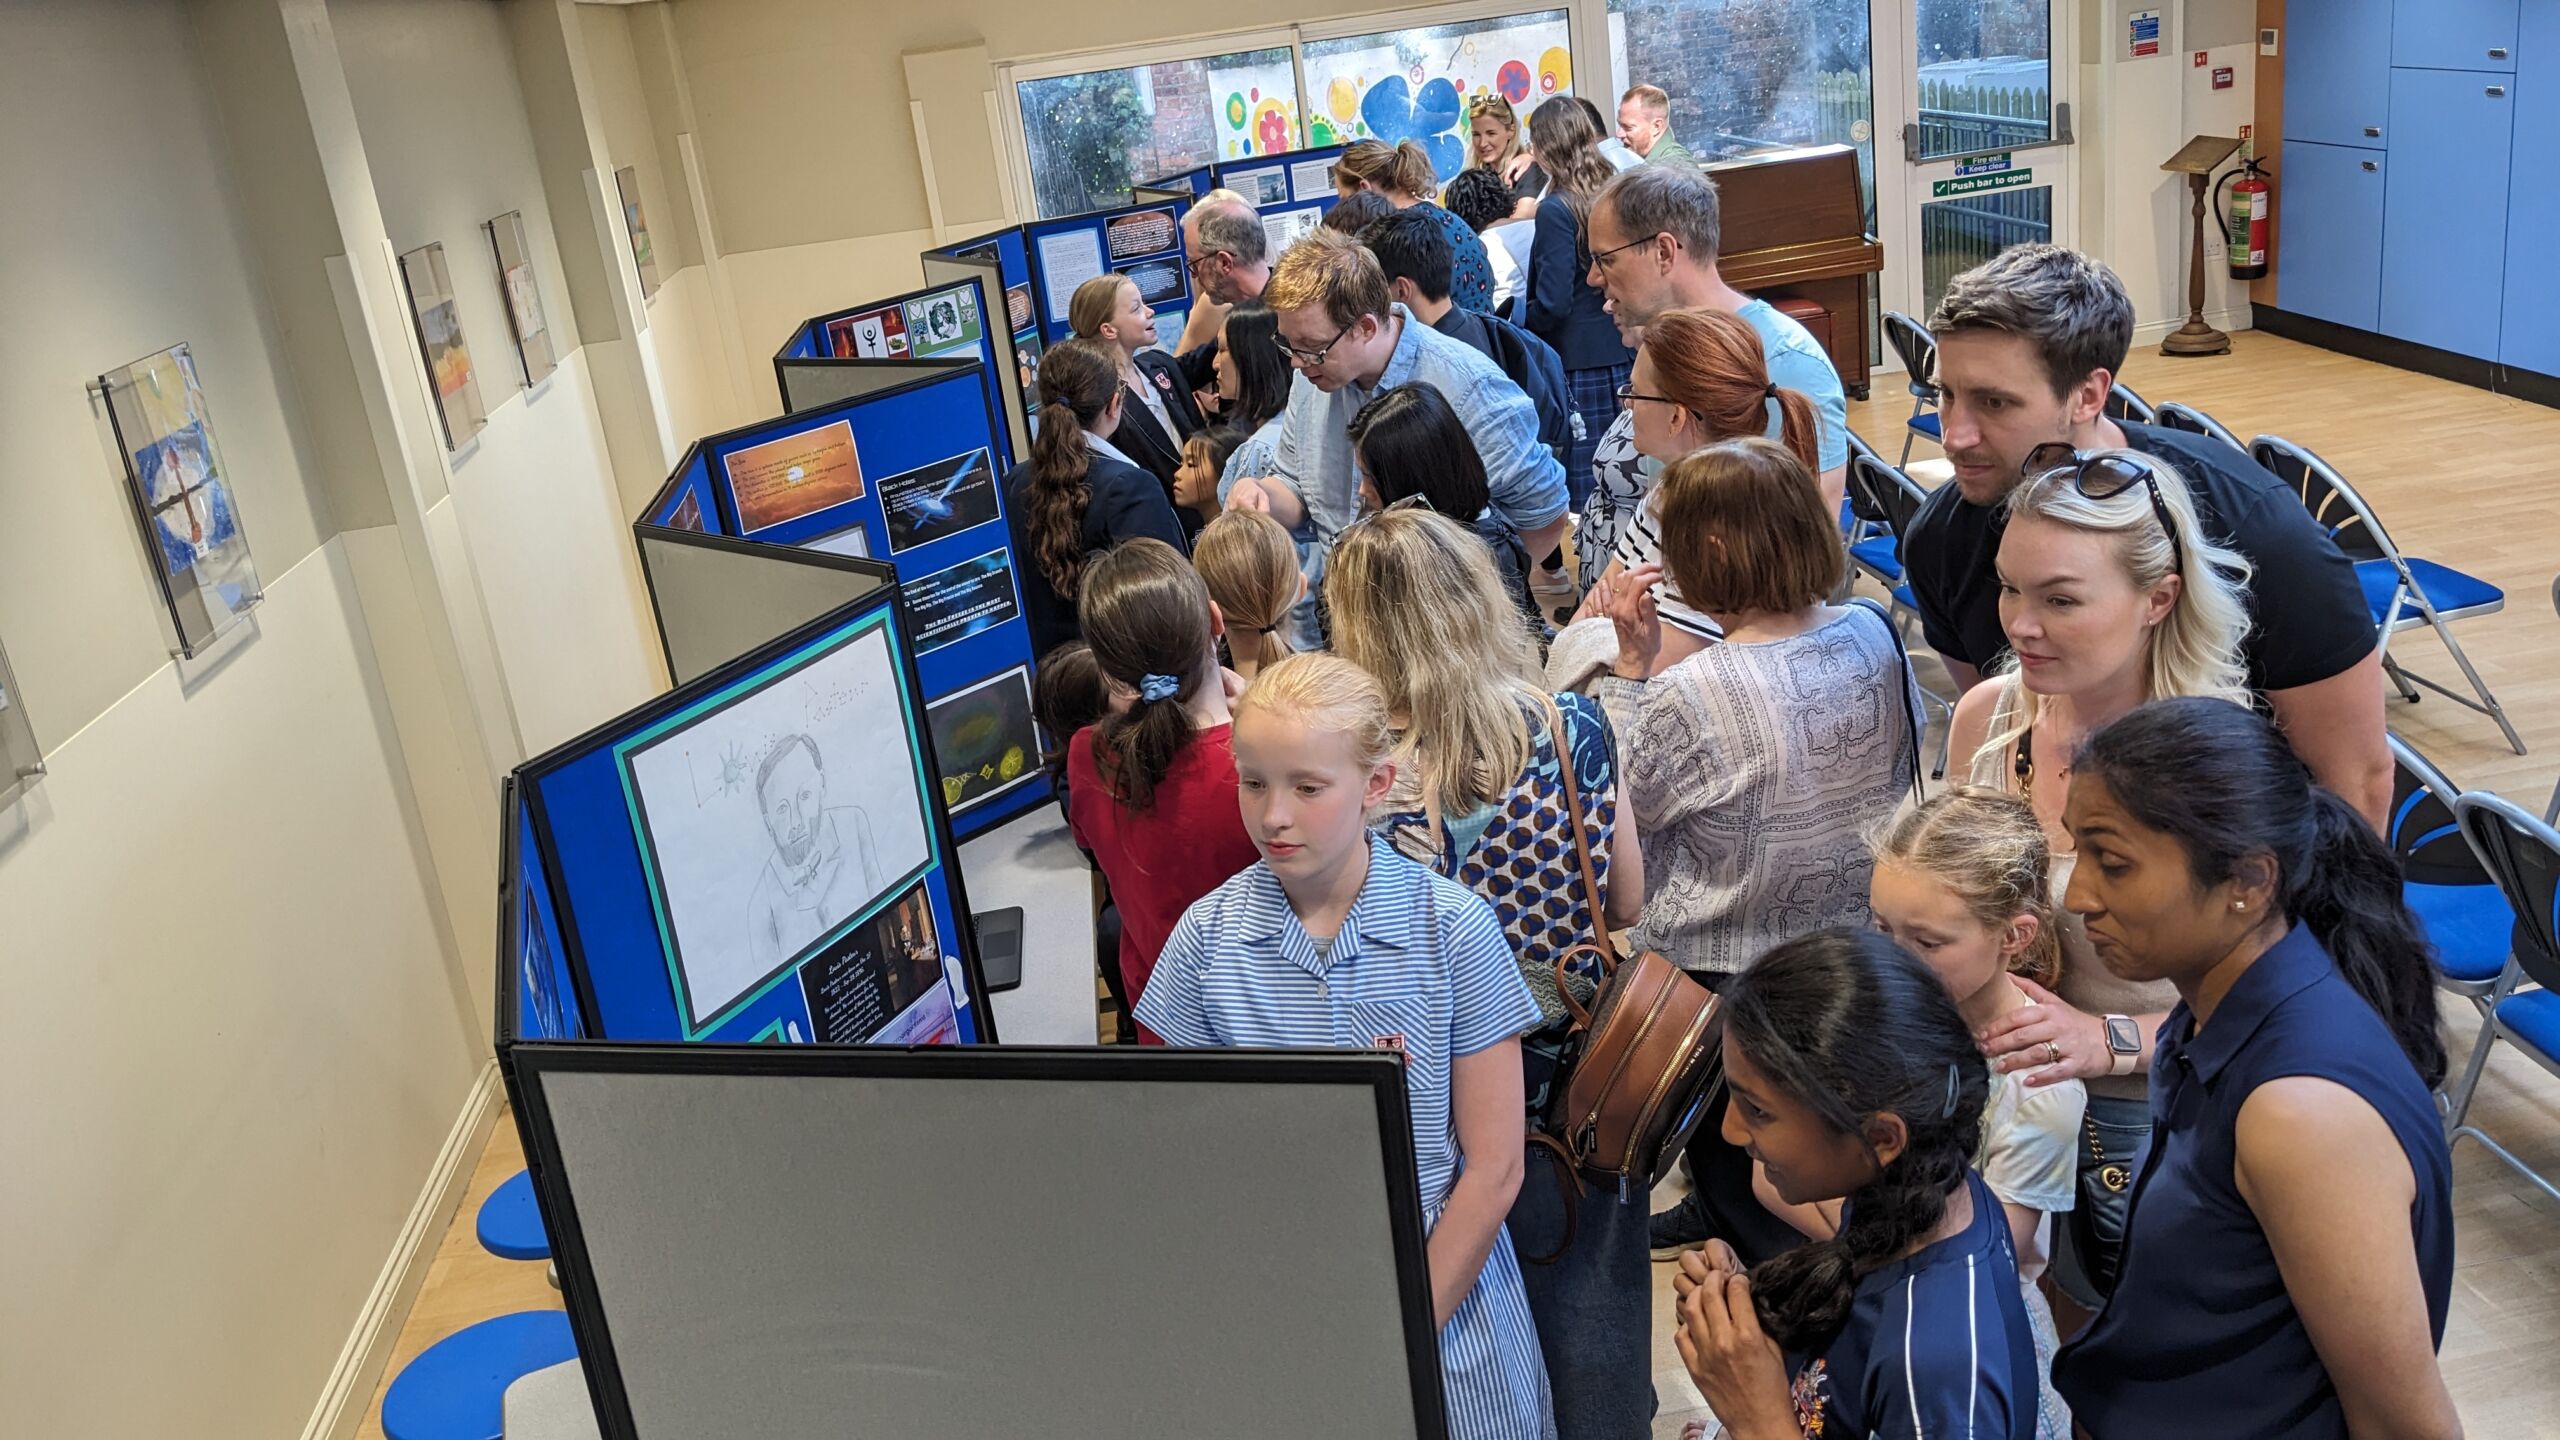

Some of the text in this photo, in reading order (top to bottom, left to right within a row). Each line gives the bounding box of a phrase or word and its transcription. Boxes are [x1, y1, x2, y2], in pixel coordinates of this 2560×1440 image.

[1988, 154, 2002, 162] exit
[1969, 164, 1987, 173] Keep
[1951, 173, 2030, 191] Push bar to open
[882, 478, 915, 492] Black Holes
[916, 621, 960, 640] SCIENTIFICALLY
[960, 612, 981, 624] PROVEN
[829, 962, 841, 975] Louis
